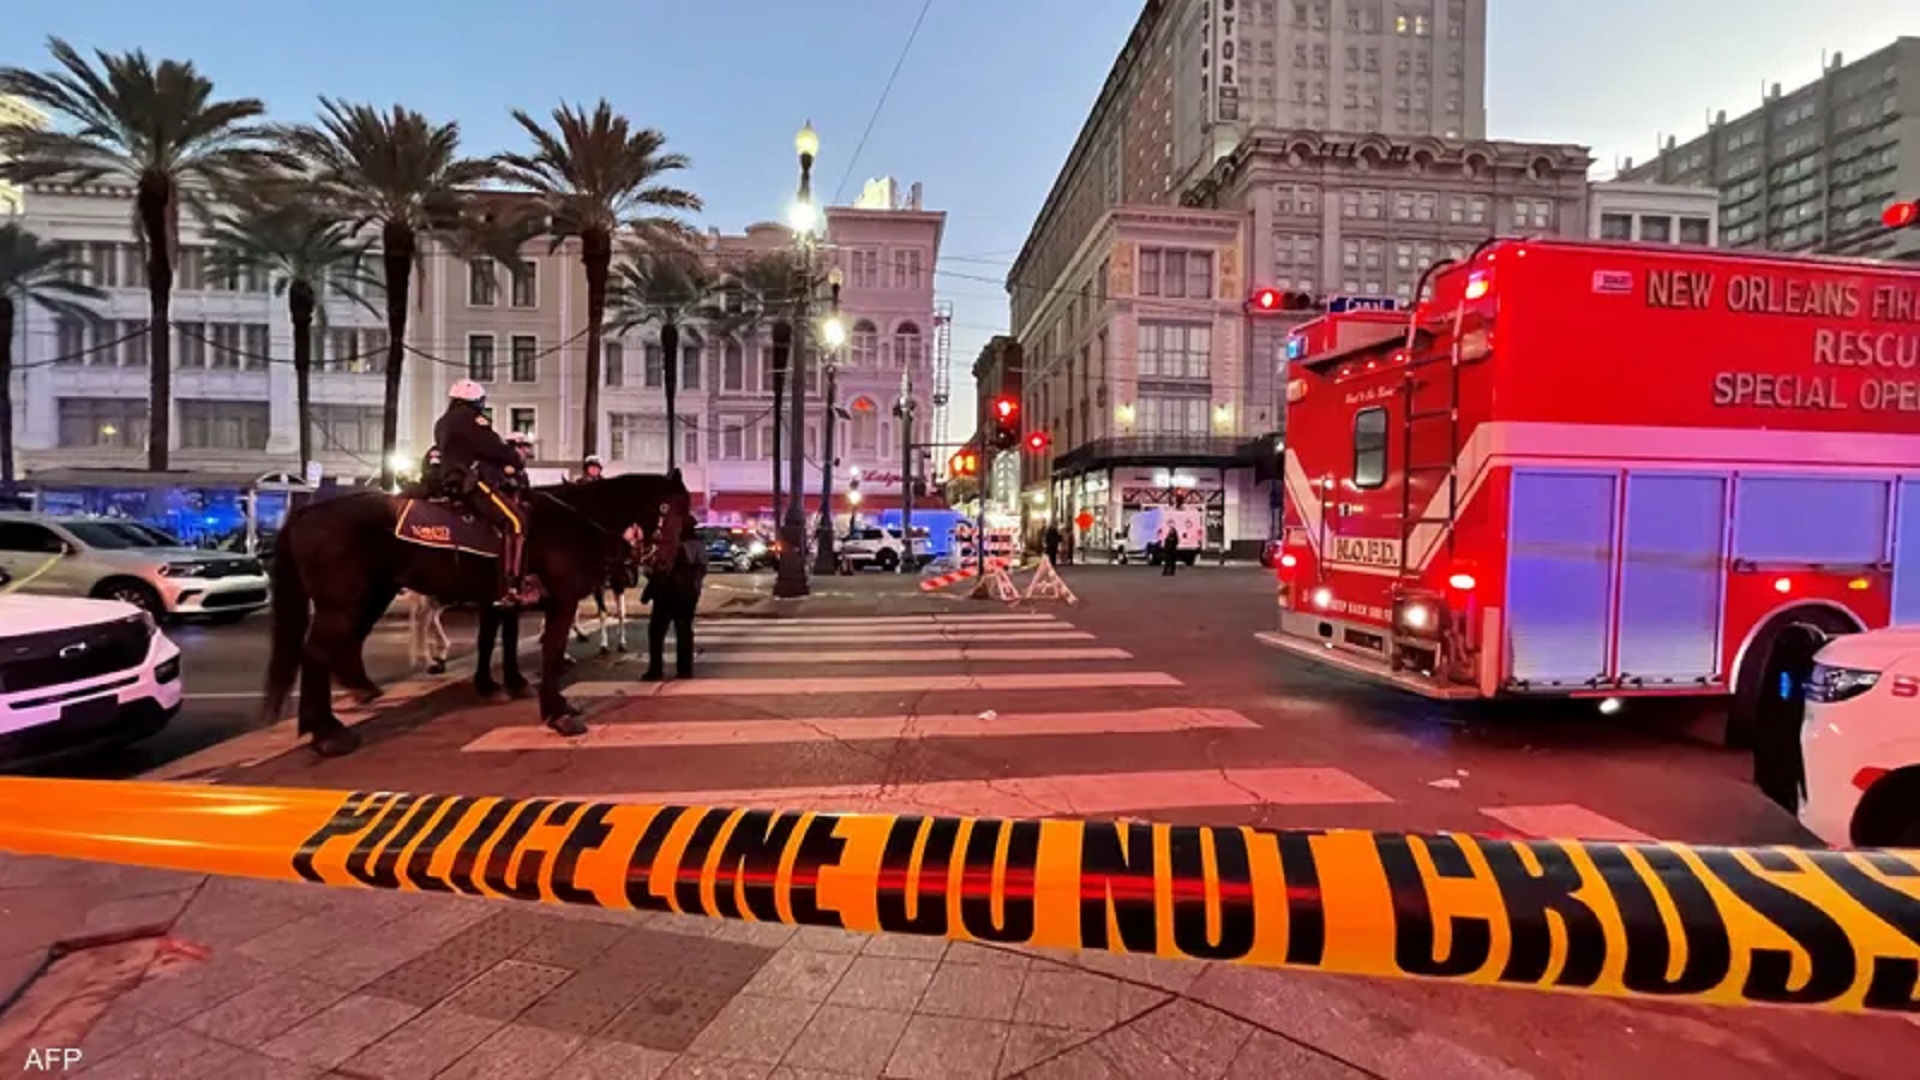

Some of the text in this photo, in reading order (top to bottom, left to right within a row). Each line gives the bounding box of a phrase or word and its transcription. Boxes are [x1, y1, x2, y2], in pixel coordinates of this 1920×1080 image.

[1646, 269, 1714, 308] NEW
[1726, 275, 1861, 318] ORLEANS
[1712, 371, 1920, 412] SPECIAL OPE
[292, 790, 617, 907] POLICE
[625, 805, 848, 927] LINE
[876, 815, 1042, 943] DO
[1079, 821, 1327, 965] NOT
